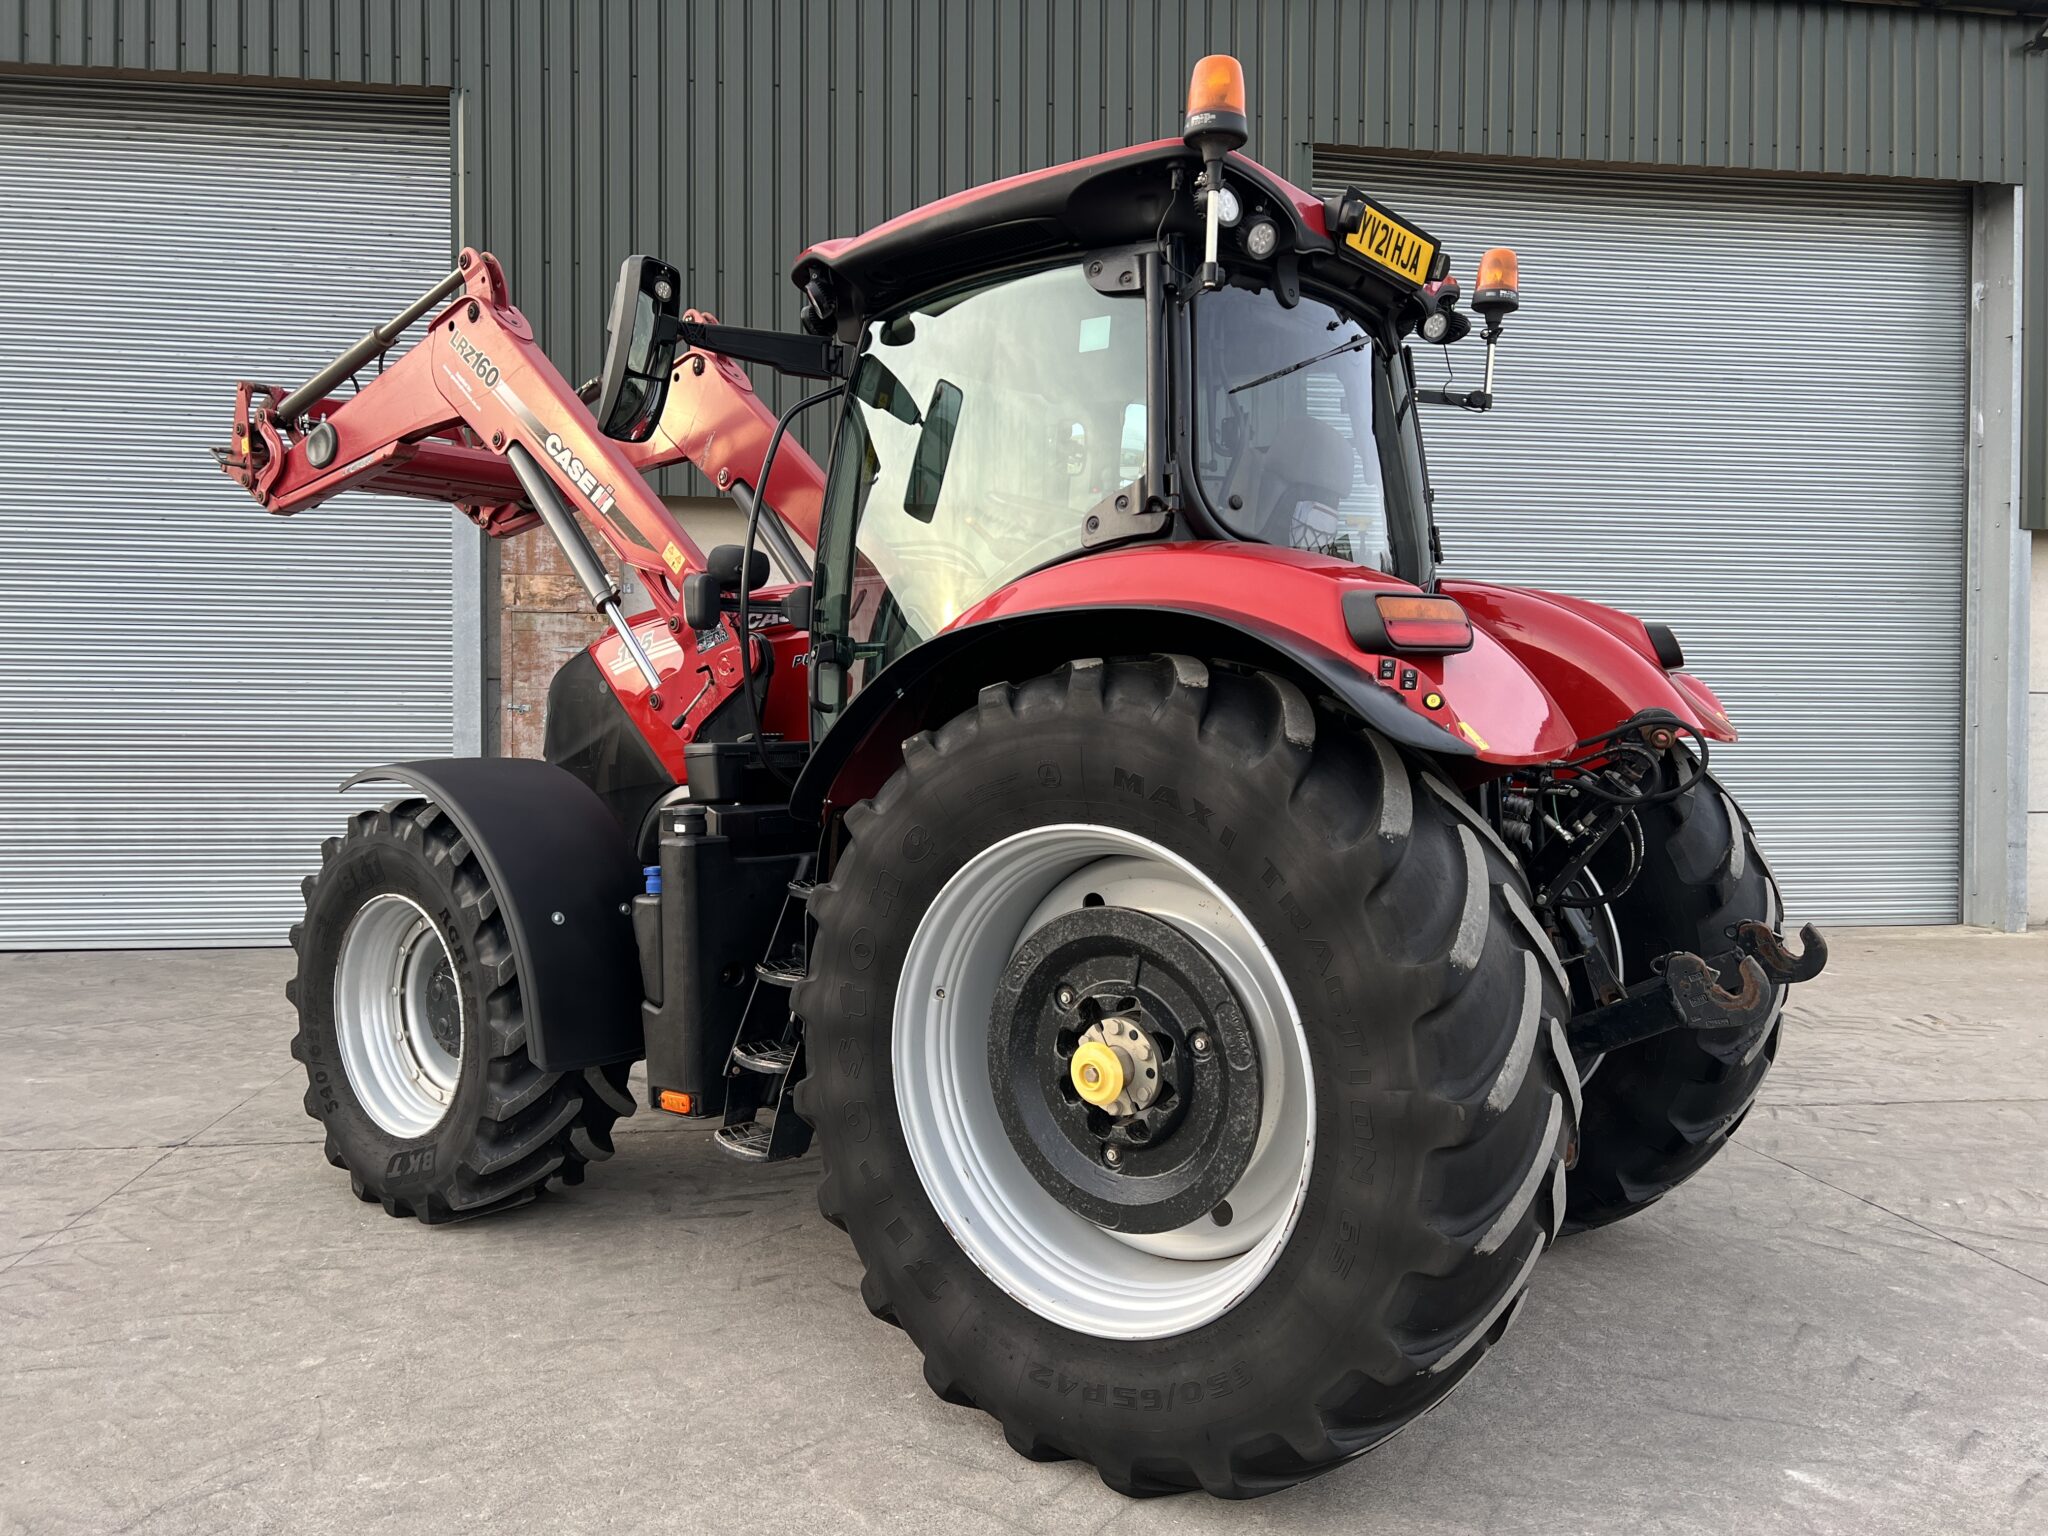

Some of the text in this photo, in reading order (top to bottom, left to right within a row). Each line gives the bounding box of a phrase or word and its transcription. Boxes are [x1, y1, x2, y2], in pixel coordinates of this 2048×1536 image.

[1359, 212, 1422, 276] YV21 HJA
[545, 433, 598, 496] CASE
[617, 630, 656, 664] 15
[385, 1145, 437, 1181] BKT
